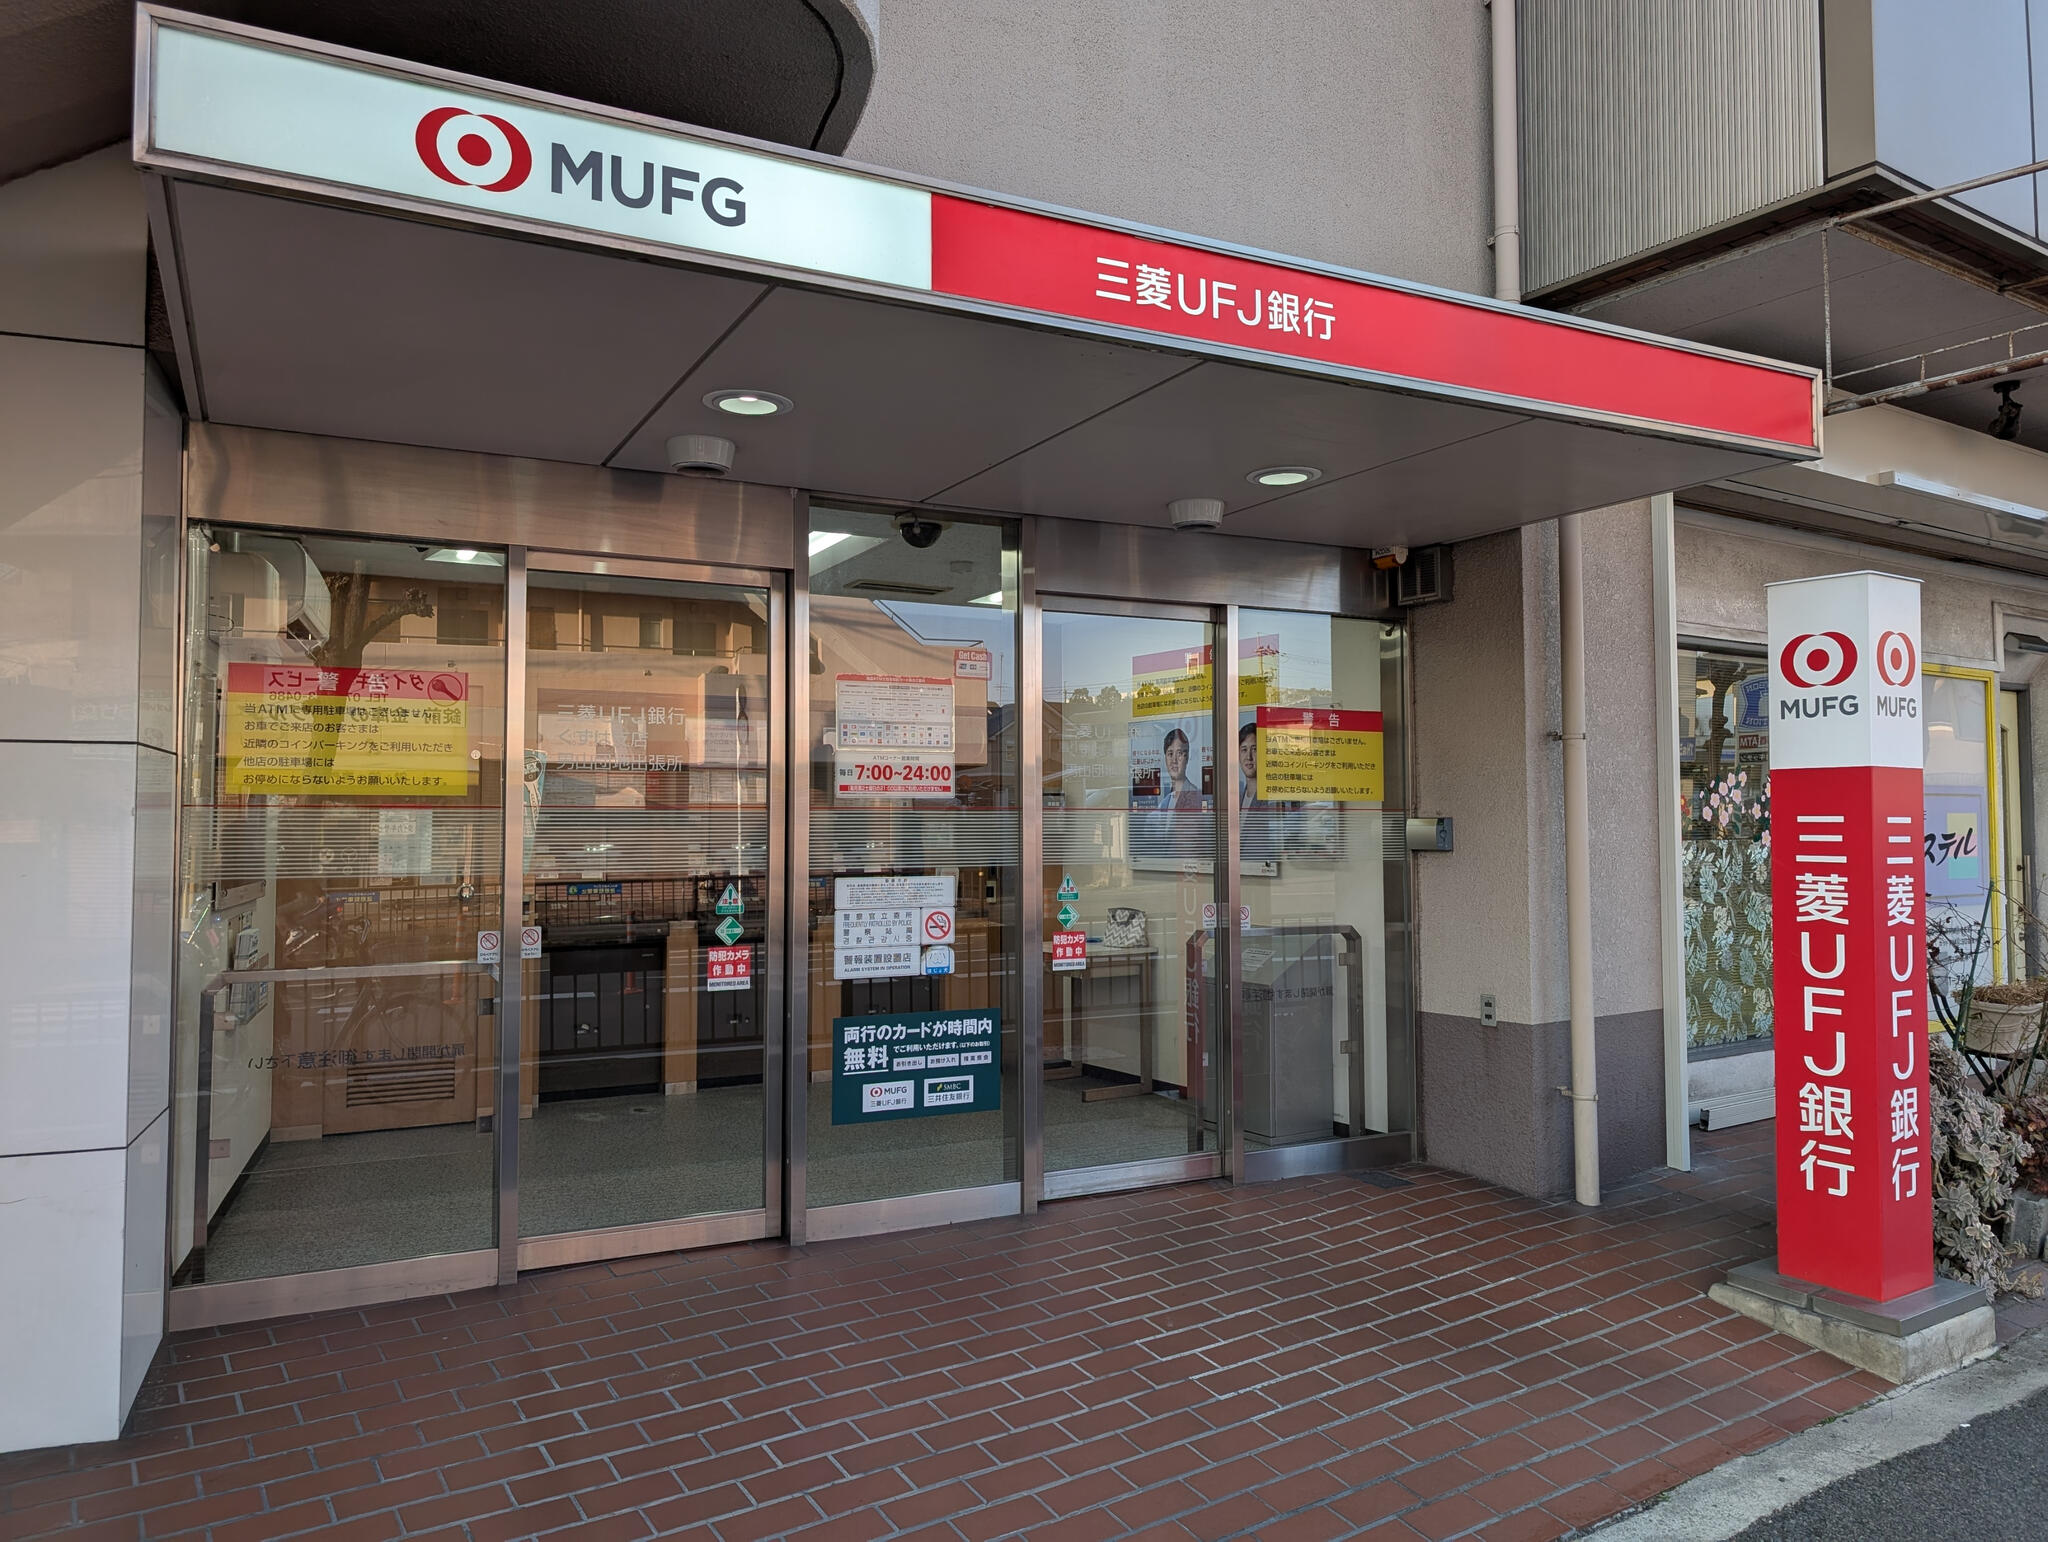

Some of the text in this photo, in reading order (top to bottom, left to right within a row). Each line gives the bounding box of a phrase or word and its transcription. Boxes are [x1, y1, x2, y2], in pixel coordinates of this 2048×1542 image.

[550, 142, 747, 228] MUFG
[1094, 256, 1337, 342] 三菱UFJ銀行
[958, 651, 987, 661] Get Cash
[1780, 695, 1860, 720] MUFG
[1877, 694, 1918, 720] MUFG
[557, 704, 685, 726] 三菱UFJ銀行
[1302, 711, 1340, 728] 警告
[244, 721, 379, 734] お車でご来店のお客さまは
[243, 738, 453, 753] 近隣のコインパーキングをご利用いただき
[243, 756, 335, 768] 他店の駐車場には
[243, 774, 447, 787] お停めにならないようお願いいたします。
[1053, 934, 1085, 945] 防犯カメラ
[708, 950, 750, 962] 防犯カメラ
[1056, 946, 1083, 957] 作動中
[844, 952, 912, 965] 警報装置設置店
[712, 963, 746, 977] 作動中
[1795, 815, 1856, 1197] 三菱UFJ銀行
[1886, 816, 1920, 1202] 三菱UFJ銀行
[844, 1018, 992, 1044] 両行のカードが時間内
[843, 1045, 889, 1072] 無料
[893, 1042, 959, 1054] でご利用いただけます。
[896, 1059, 923, 1068] お引き出し
[884, 1086, 908, 1095] MUFG
[870, 1098, 907, 1108] 三菱UFJ銀行
[928, 1092, 970, 1104] 三井住友銀行
